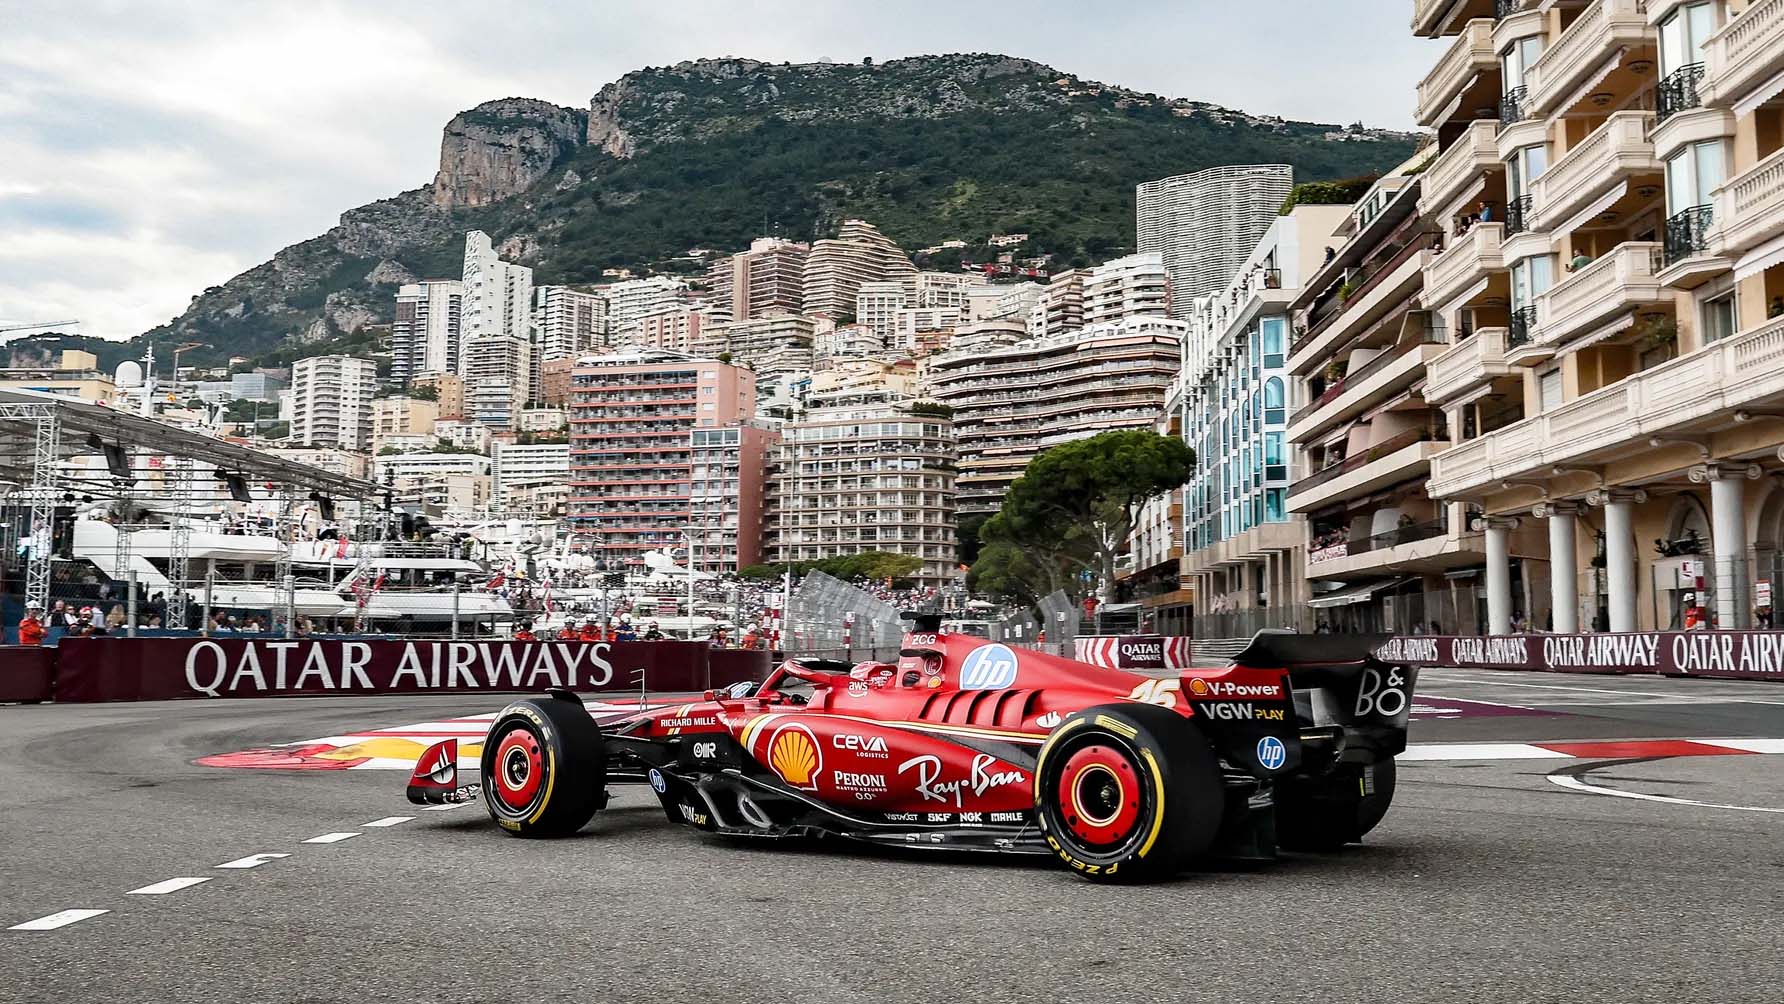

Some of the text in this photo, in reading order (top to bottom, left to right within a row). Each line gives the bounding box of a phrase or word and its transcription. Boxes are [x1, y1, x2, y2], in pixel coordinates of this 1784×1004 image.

[912, 634, 936, 645] ZCG
[1121, 644, 1160, 656] QATAR
[1451, 638, 1528, 665] QATAR AIRWAYS
[1543, 635, 1660, 669] QATAR AIRWAY
[1673, 634, 1735, 673] QATAR
[185, 641, 613, 697] QATAR AIRWAYS
[965, 645, 1014, 690] hp
[848, 681, 868, 691] aws
[1208, 682, 1279, 696] V-Power
[1201, 703, 1284, 720] VGW PLAY
[660, 717, 716, 727] RICHARD MILLE
[856, 751, 888, 759] LOGISTICS
[1260, 737, 1284, 769] hp
[834, 770, 887, 787] PERONI
[928, 813, 952, 822] SKF
[960, 812, 982, 822] NGK
[991, 812, 1023, 822] MAHLE
[1047, 835, 1119, 875] P ZERO
